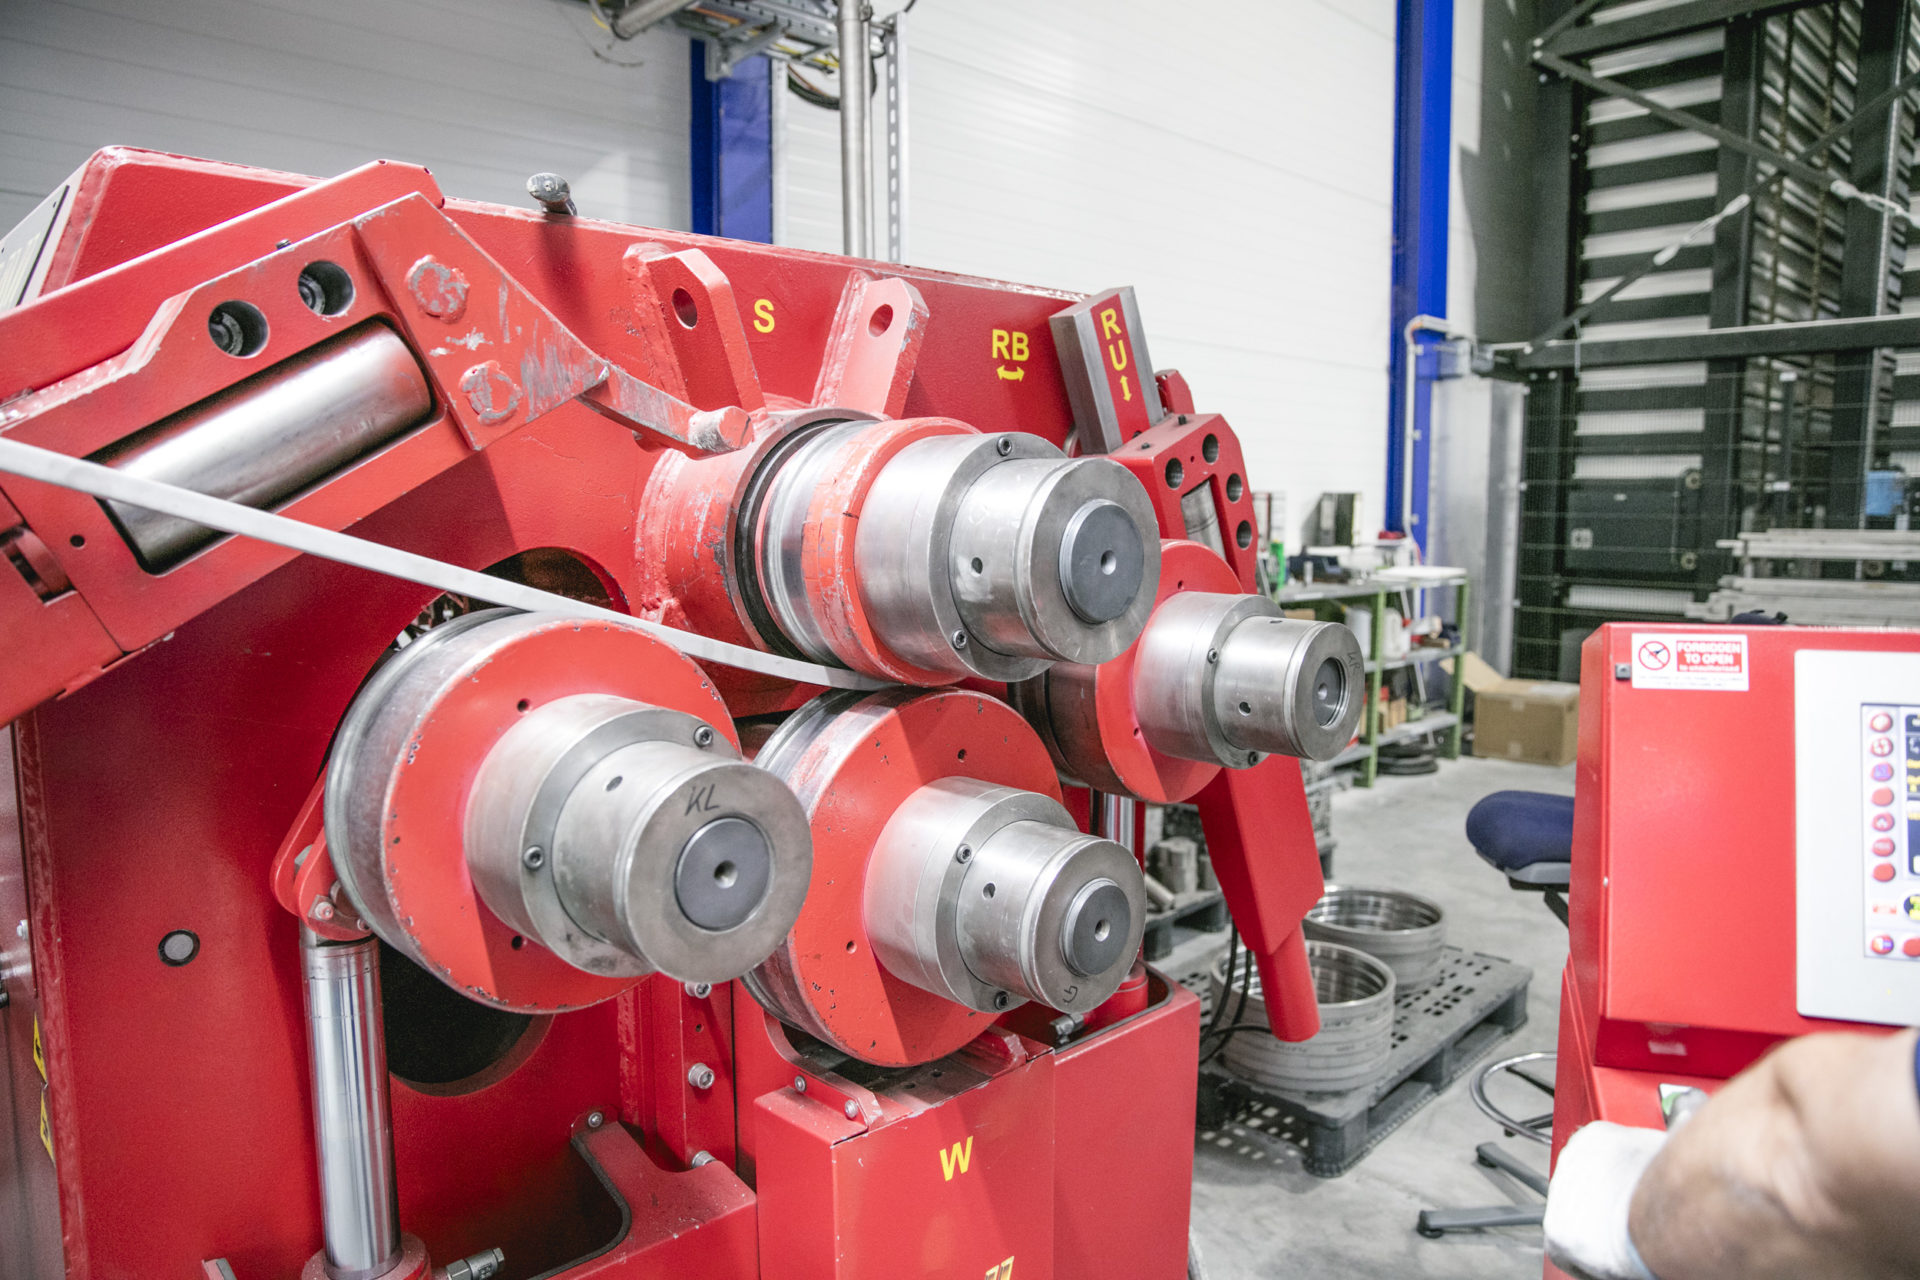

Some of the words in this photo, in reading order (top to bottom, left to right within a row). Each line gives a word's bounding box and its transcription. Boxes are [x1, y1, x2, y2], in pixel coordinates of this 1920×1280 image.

[753, 299, 775, 333] S
[992, 329, 1030, 361] RB
[1677, 642, 1740, 654] FORBIDDEN
[1684, 653, 1701, 664] TO
[1702, 653, 1734, 665] OPEN
[684, 784, 720, 816] KL
[939, 1135, 974, 1182] W
